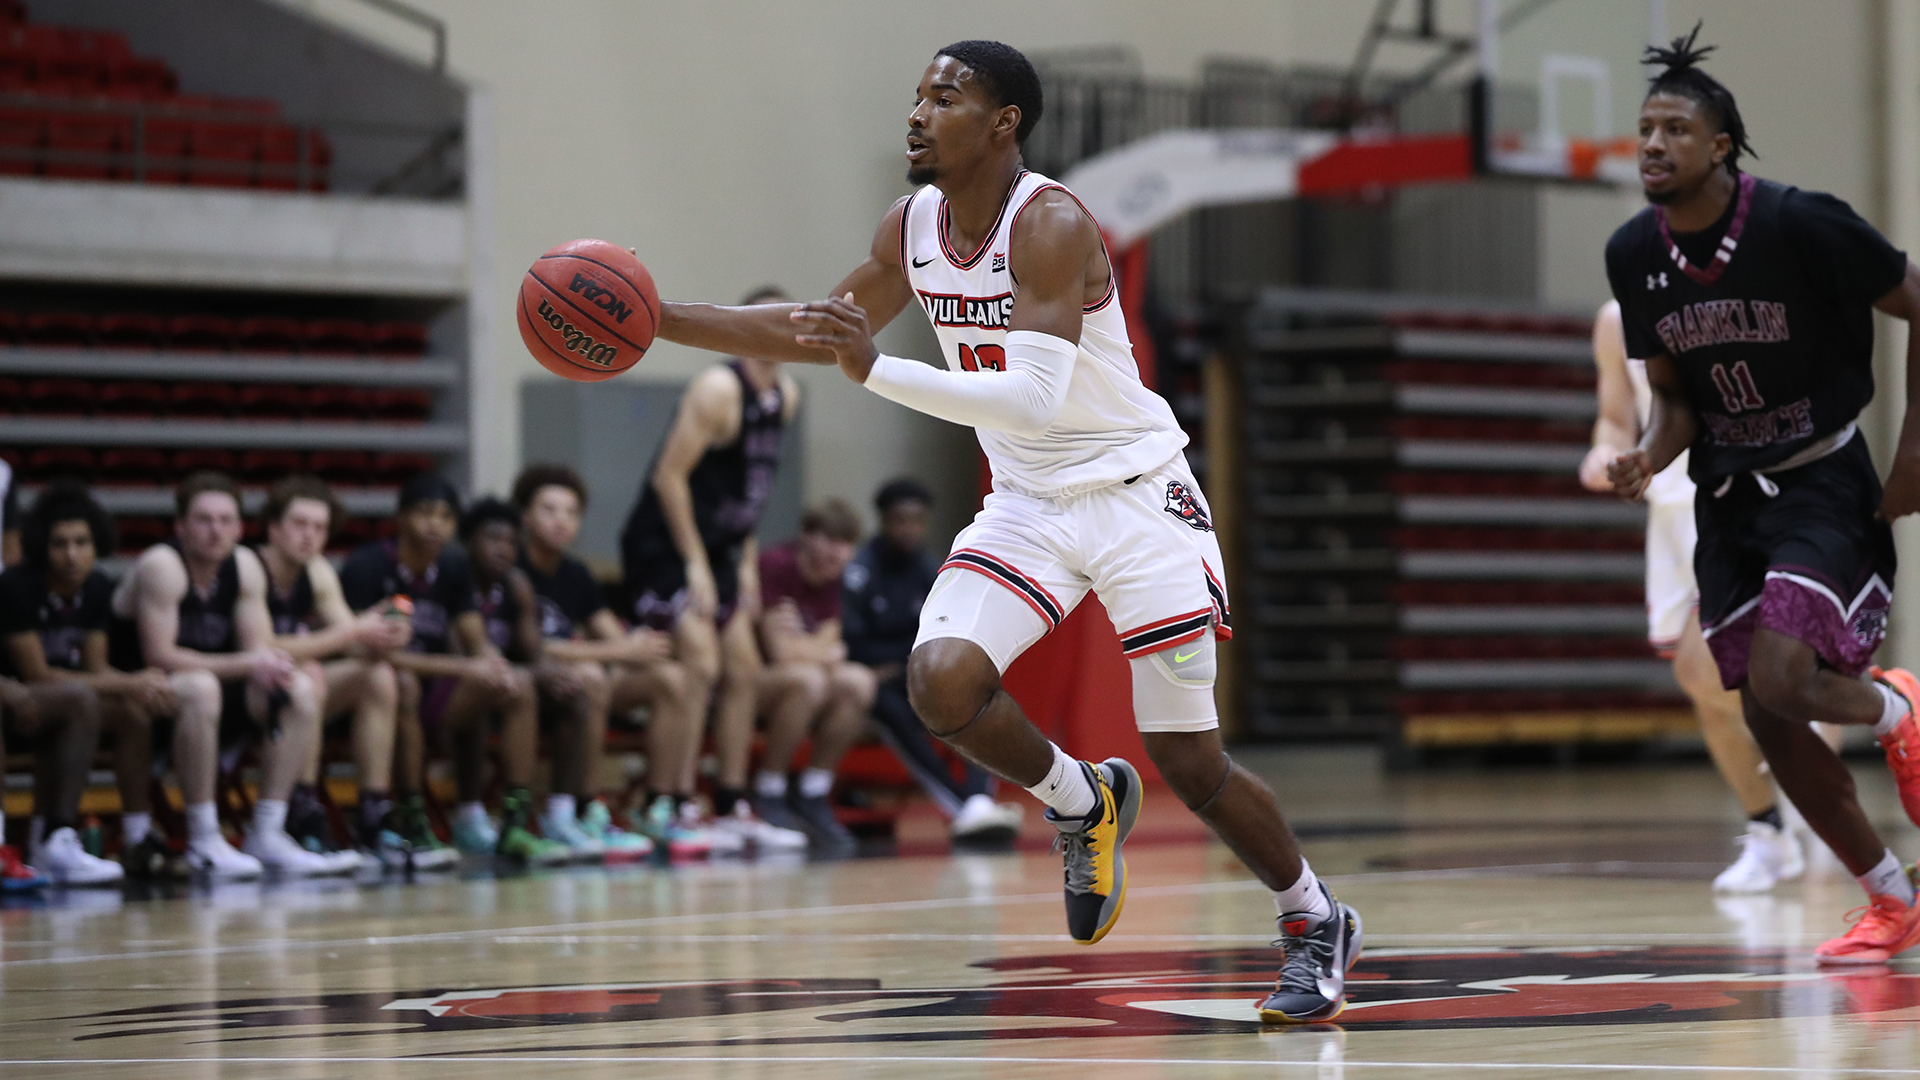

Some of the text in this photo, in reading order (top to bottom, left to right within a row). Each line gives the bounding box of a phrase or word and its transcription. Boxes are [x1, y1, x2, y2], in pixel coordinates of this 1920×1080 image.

[568, 272, 634, 324] NCAA
[920, 291, 1014, 329] VULCANS
[537, 296, 618, 367] Wilson
[1711, 360, 1765, 413] 11
